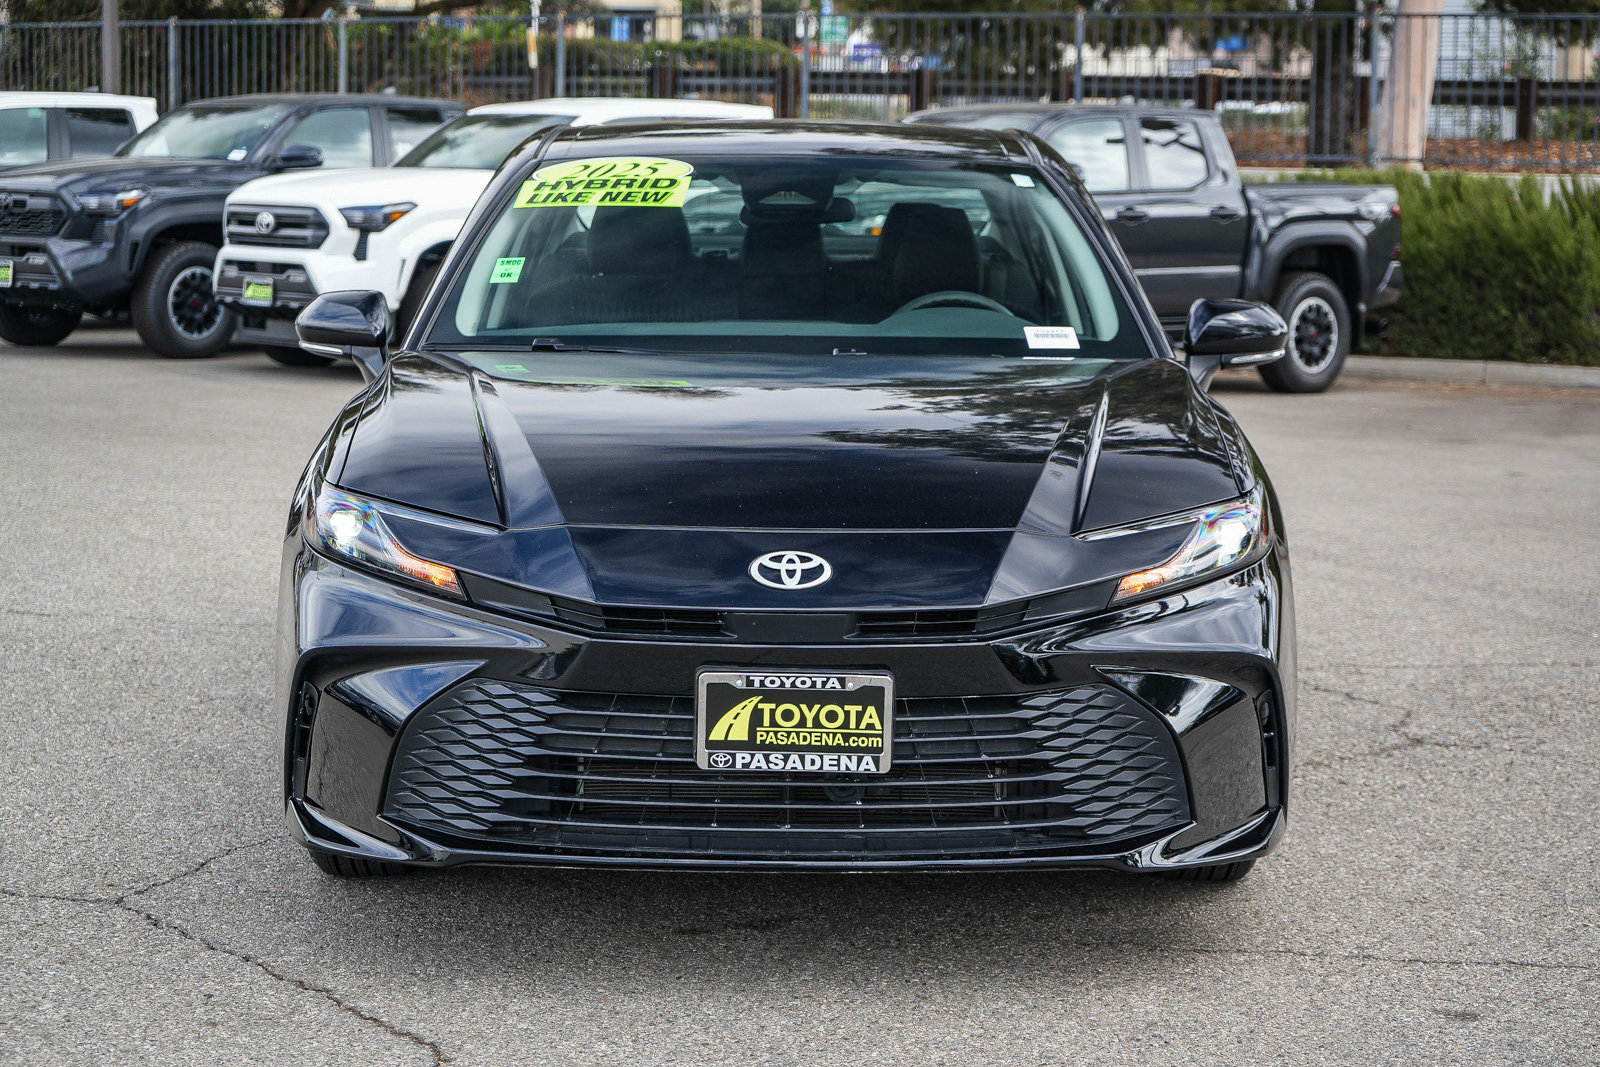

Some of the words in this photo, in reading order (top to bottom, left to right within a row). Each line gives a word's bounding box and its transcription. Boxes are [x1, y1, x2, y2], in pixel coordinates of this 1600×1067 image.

[556, 162, 668, 179] 2025
[534, 178, 679, 191] HYBRID
[525, 191, 592, 204] LIKE
[599, 191, 674, 203] NEW
[750, 676, 842, 689] TOYOTA
[757, 703, 882, 730] TOYOTA
[757, 731, 882, 748] PASADENA.com
[735, 753, 877, 772] PASADENA
